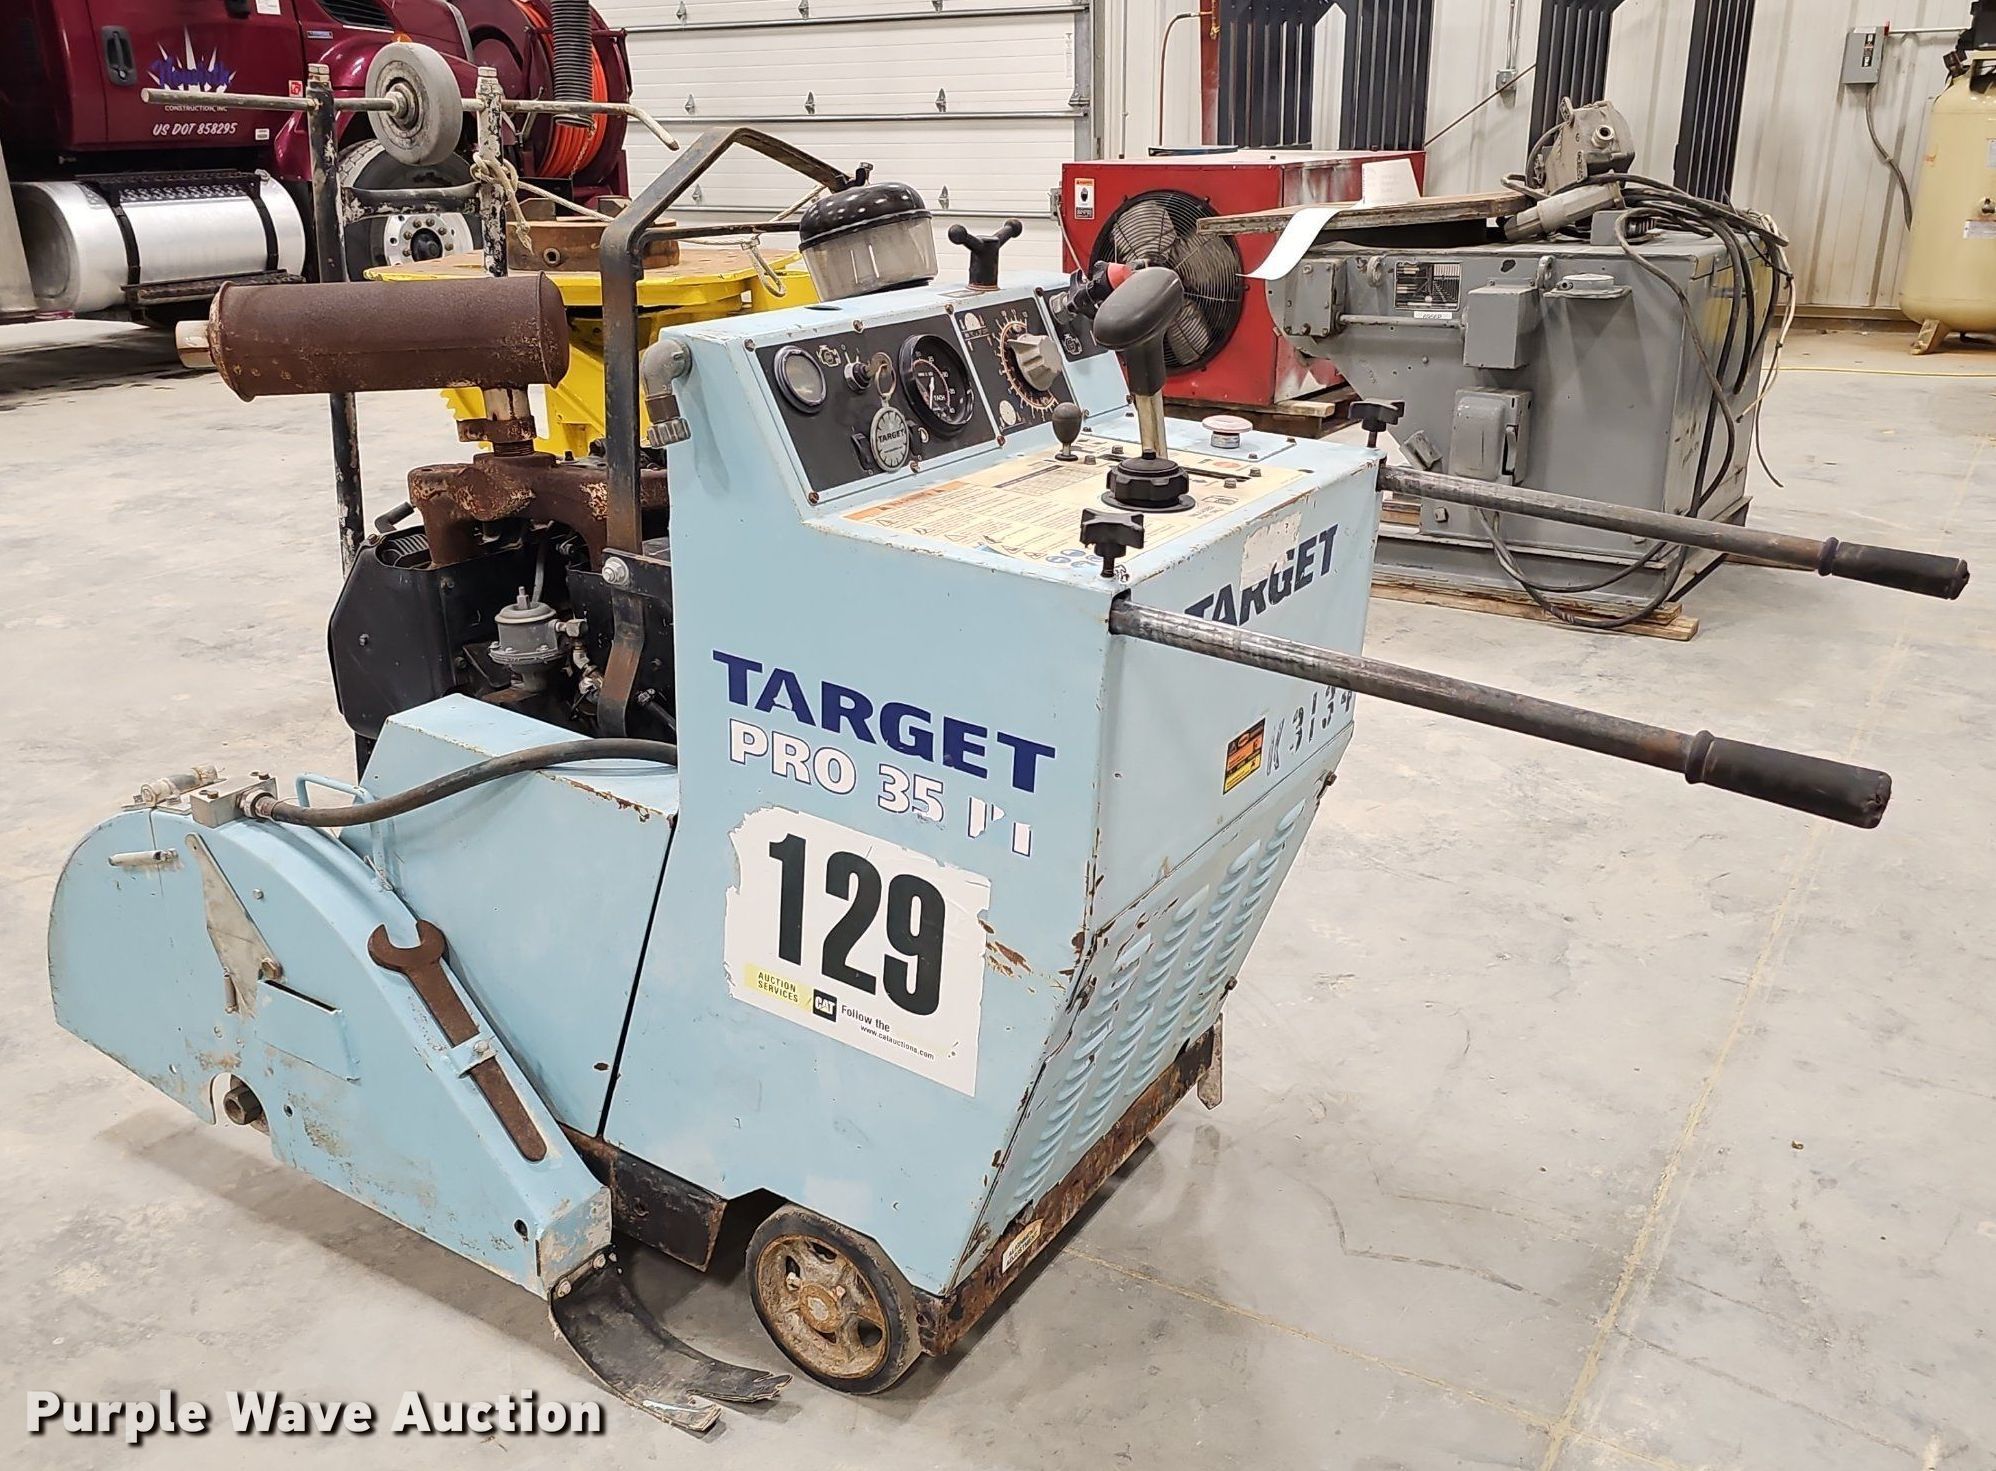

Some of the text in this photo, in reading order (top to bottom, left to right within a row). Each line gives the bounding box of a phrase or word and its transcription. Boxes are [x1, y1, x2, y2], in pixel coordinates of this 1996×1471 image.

[153, 122, 238, 136] US DOT 858295
[878, 429, 905, 443] TARGET
[712, 649, 1056, 794] TARGET
[729, 718, 857, 795] PRO
[877, 763, 945, 823] 35
[769, 833, 946, 1016] 129
[758, 971, 797, 993] AUCTION
[758, 980, 799, 1004] SERVICES
[814, 995, 836, 1016] CAT
[841, 1004, 891, 1032] Follow the
[860, 1024, 935, 1060] www.catauctions.com
